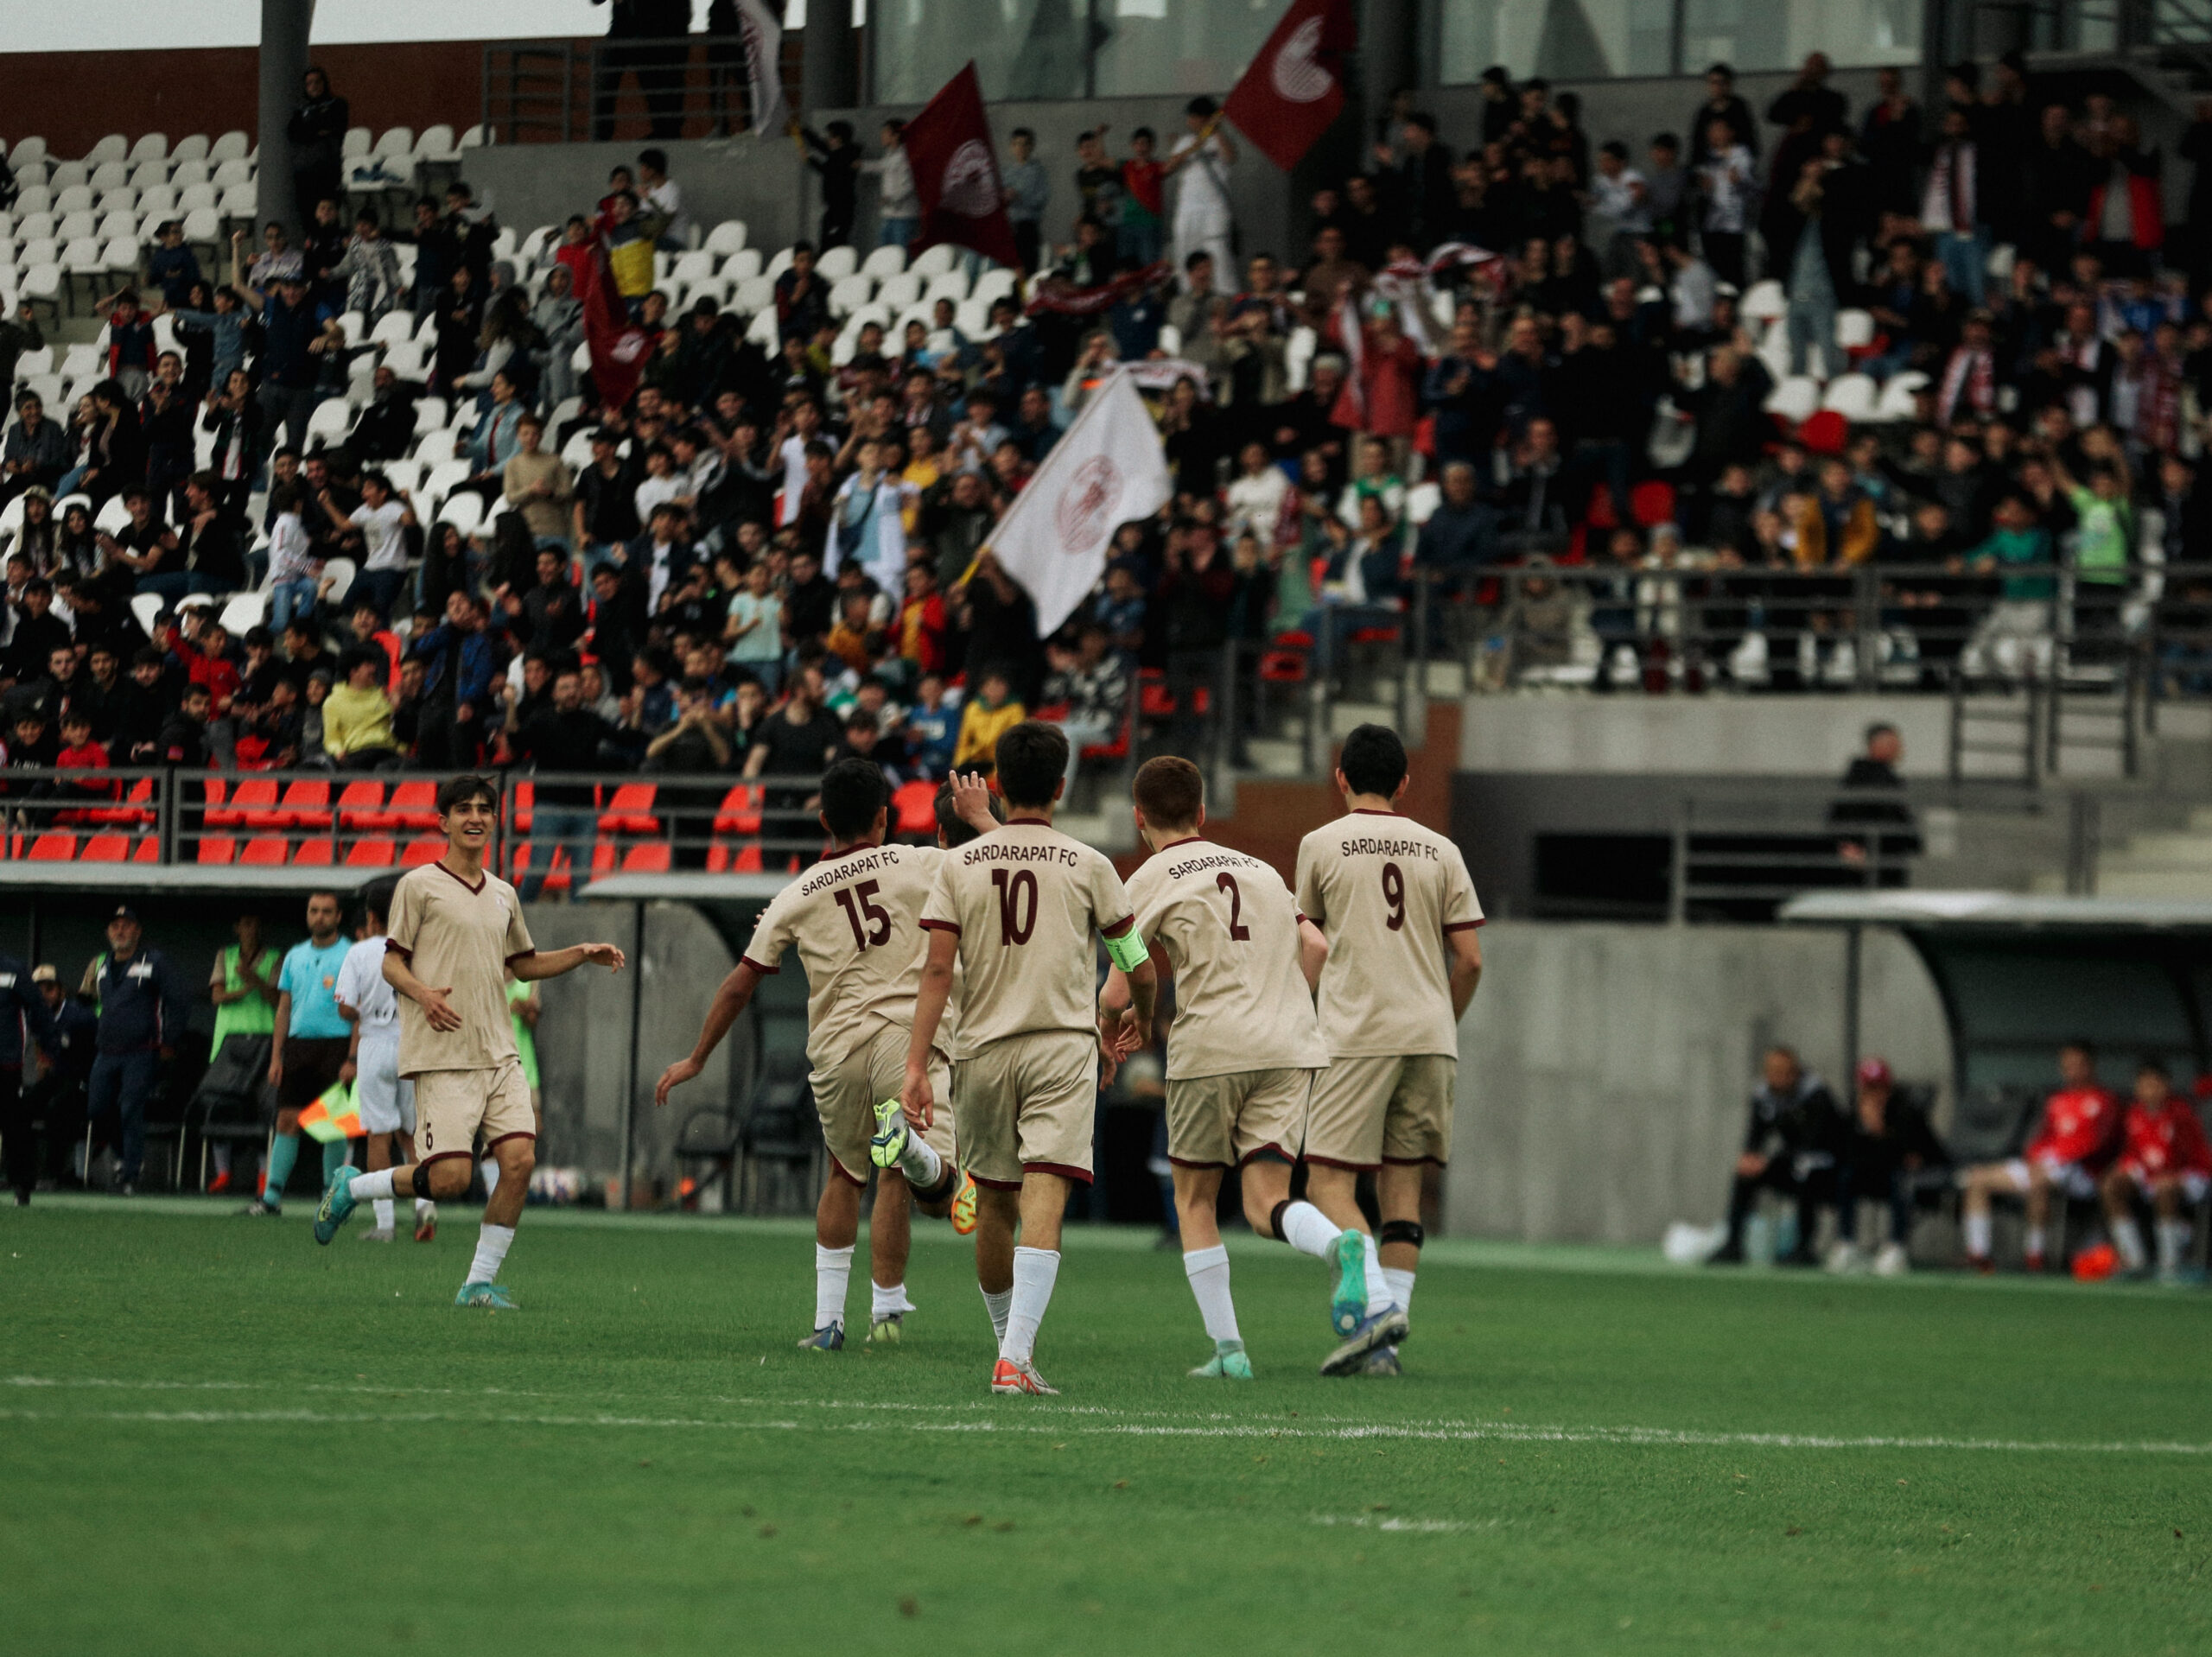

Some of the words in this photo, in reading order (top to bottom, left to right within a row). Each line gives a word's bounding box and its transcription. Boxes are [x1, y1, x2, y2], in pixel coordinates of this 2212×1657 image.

[963, 844, 1057, 866] SARDARAPAT
[1058, 848, 1078, 867] FC
[1168, 855, 1243, 879] SARDARAPAT
[1242, 857, 1259, 869] FC
[1341, 838, 1422, 857] SARDARAPAT
[1425, 844, 1439, 861] FC
[802, 854, 880, 896] SARDARAPAT
[880, 851, 899, 866] FC
[833, 879, 892, 952] 15
[992, 868, 1038, 946] 10
[1216, 872, 1251, 941] 2
[1382, 862, 1406, 931] 9
[426, 1122, 434, 1151] 6
